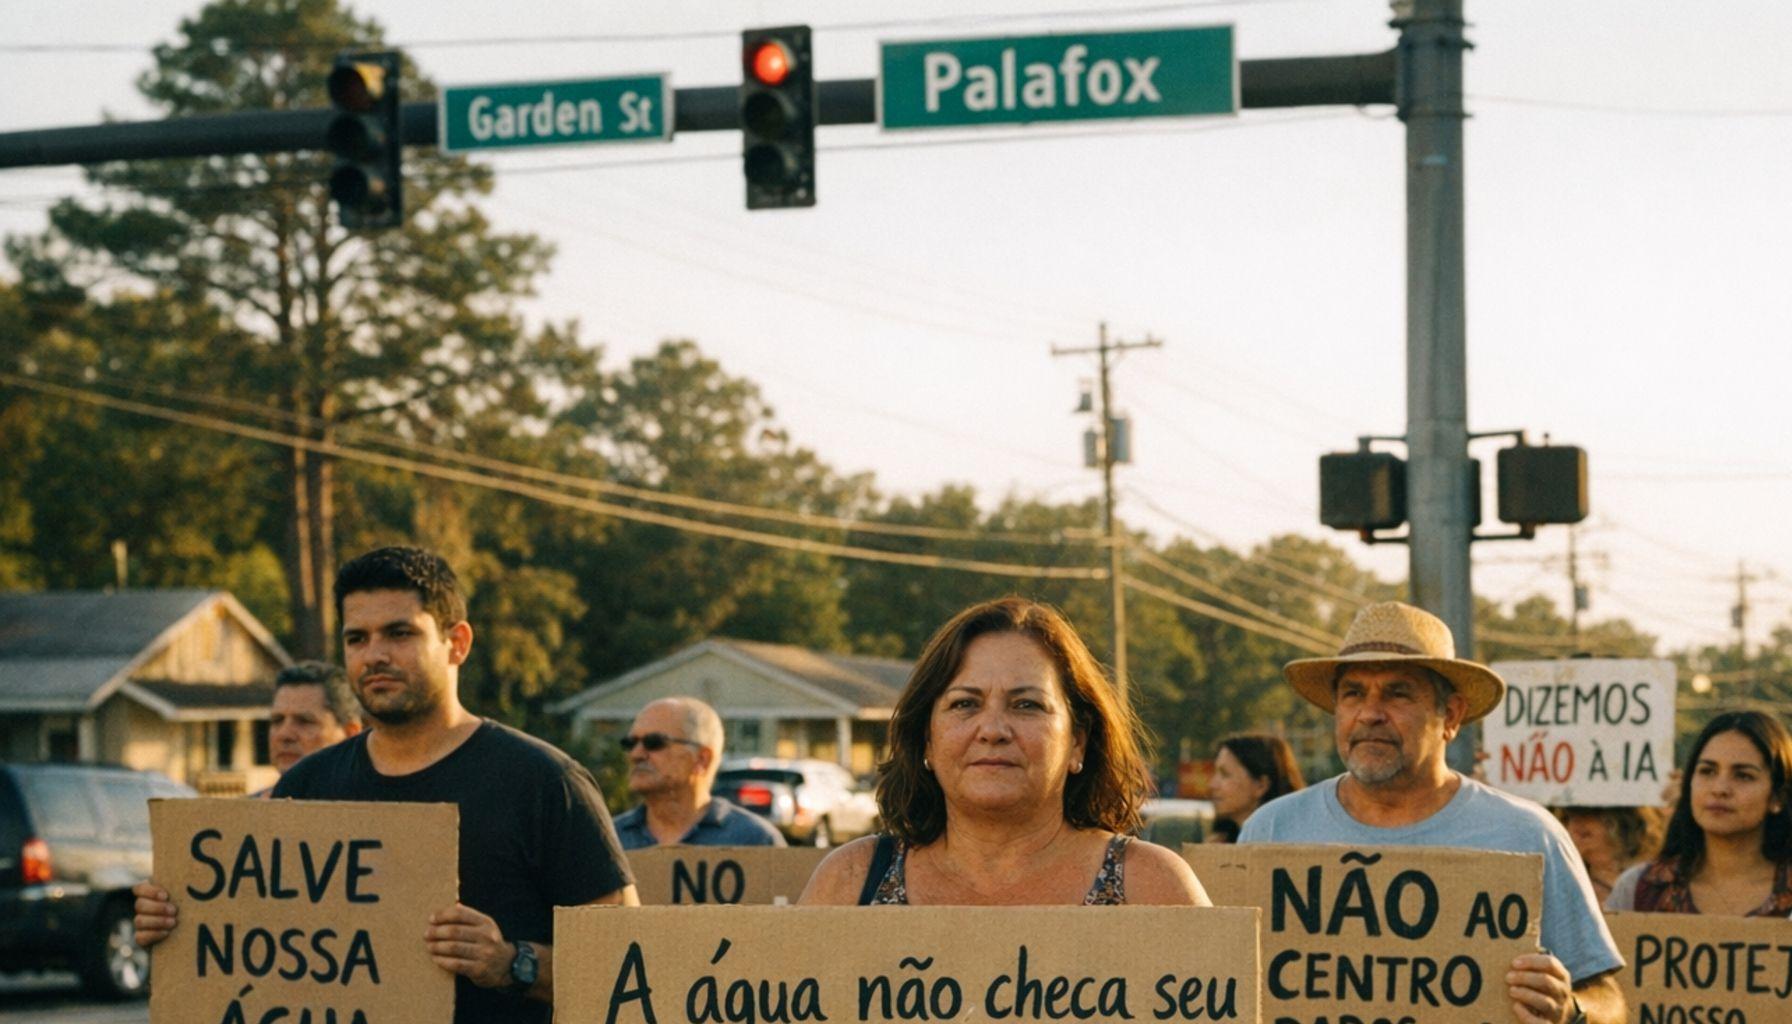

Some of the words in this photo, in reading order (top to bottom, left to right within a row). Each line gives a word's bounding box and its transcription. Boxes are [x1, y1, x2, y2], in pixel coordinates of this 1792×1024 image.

[924, 44, 1162, 113] Palafox
[468, 89, 602, 141] Garden
[618, 91, 653, 132] St
[1504, 682, 1651, 727] DIZEMOS
[1588, 738, 1609, 782] À
[1622, 741, 1658, 782] IA
[187, 828, 382, 903] SALVE
[672, 859, 746, 904] NO
[1271, 851, 1440, 941] NÃO
[1464, 891, 1529, 940] AO
[197, 923, 381, 987] NOSSA
[605, 941, 658, 1024] A
[686, 937, 829, 1024] água
[858, 956, 963, 1022] não
[984, 944, 1136, 1020] checa
[1152, 973, 1238, 1022] seu
[1267, 949, 1483, 1008] CENTRO
